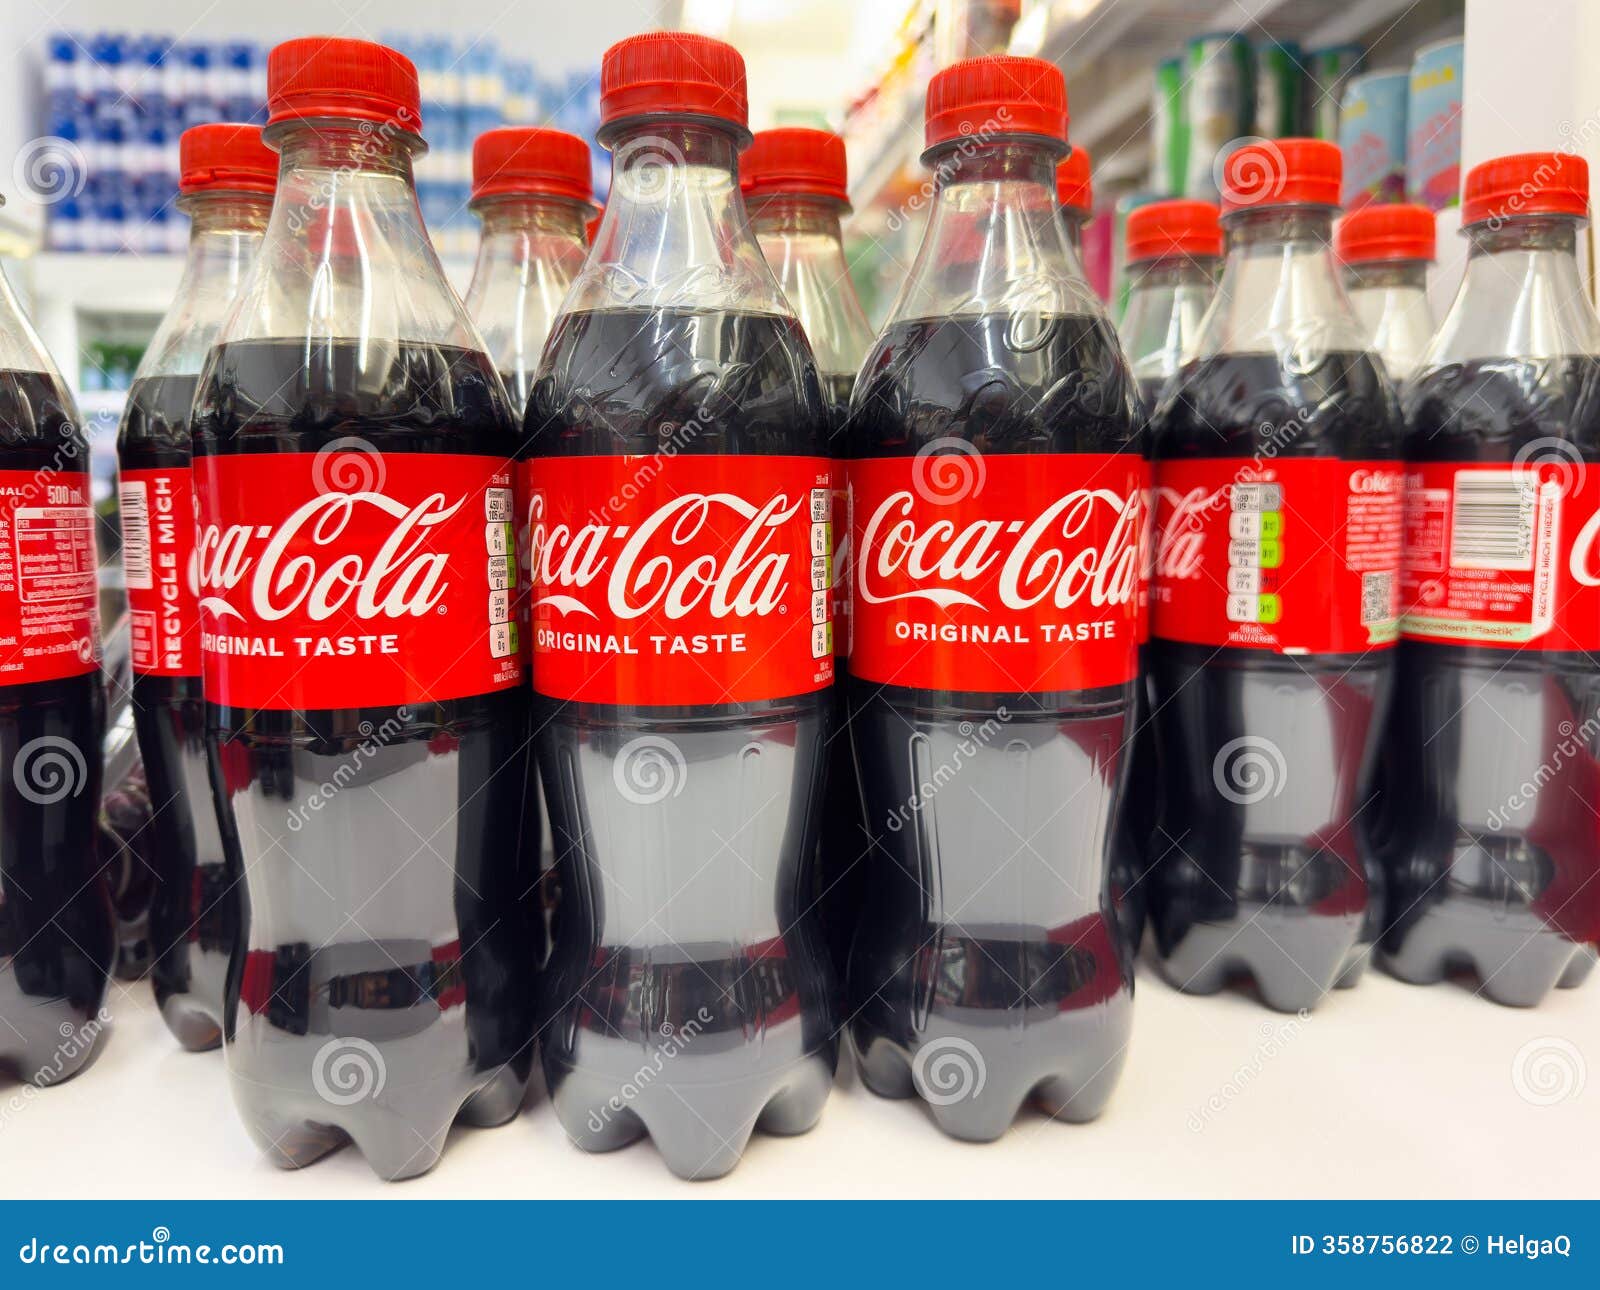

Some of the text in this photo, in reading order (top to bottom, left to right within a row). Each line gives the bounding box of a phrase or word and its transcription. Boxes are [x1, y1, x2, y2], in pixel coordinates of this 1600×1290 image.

[47, 485, 69, 505] 500
[154, 477, 183, 669] RECYCLE MICH
[538, 632, 639, 654] ORIGINAL
[650, 633, 747, 655] TASTE
[895, 620, 1116, 644] ORIGINAL TASTE
[294, 634, 399, 657] TASTE
